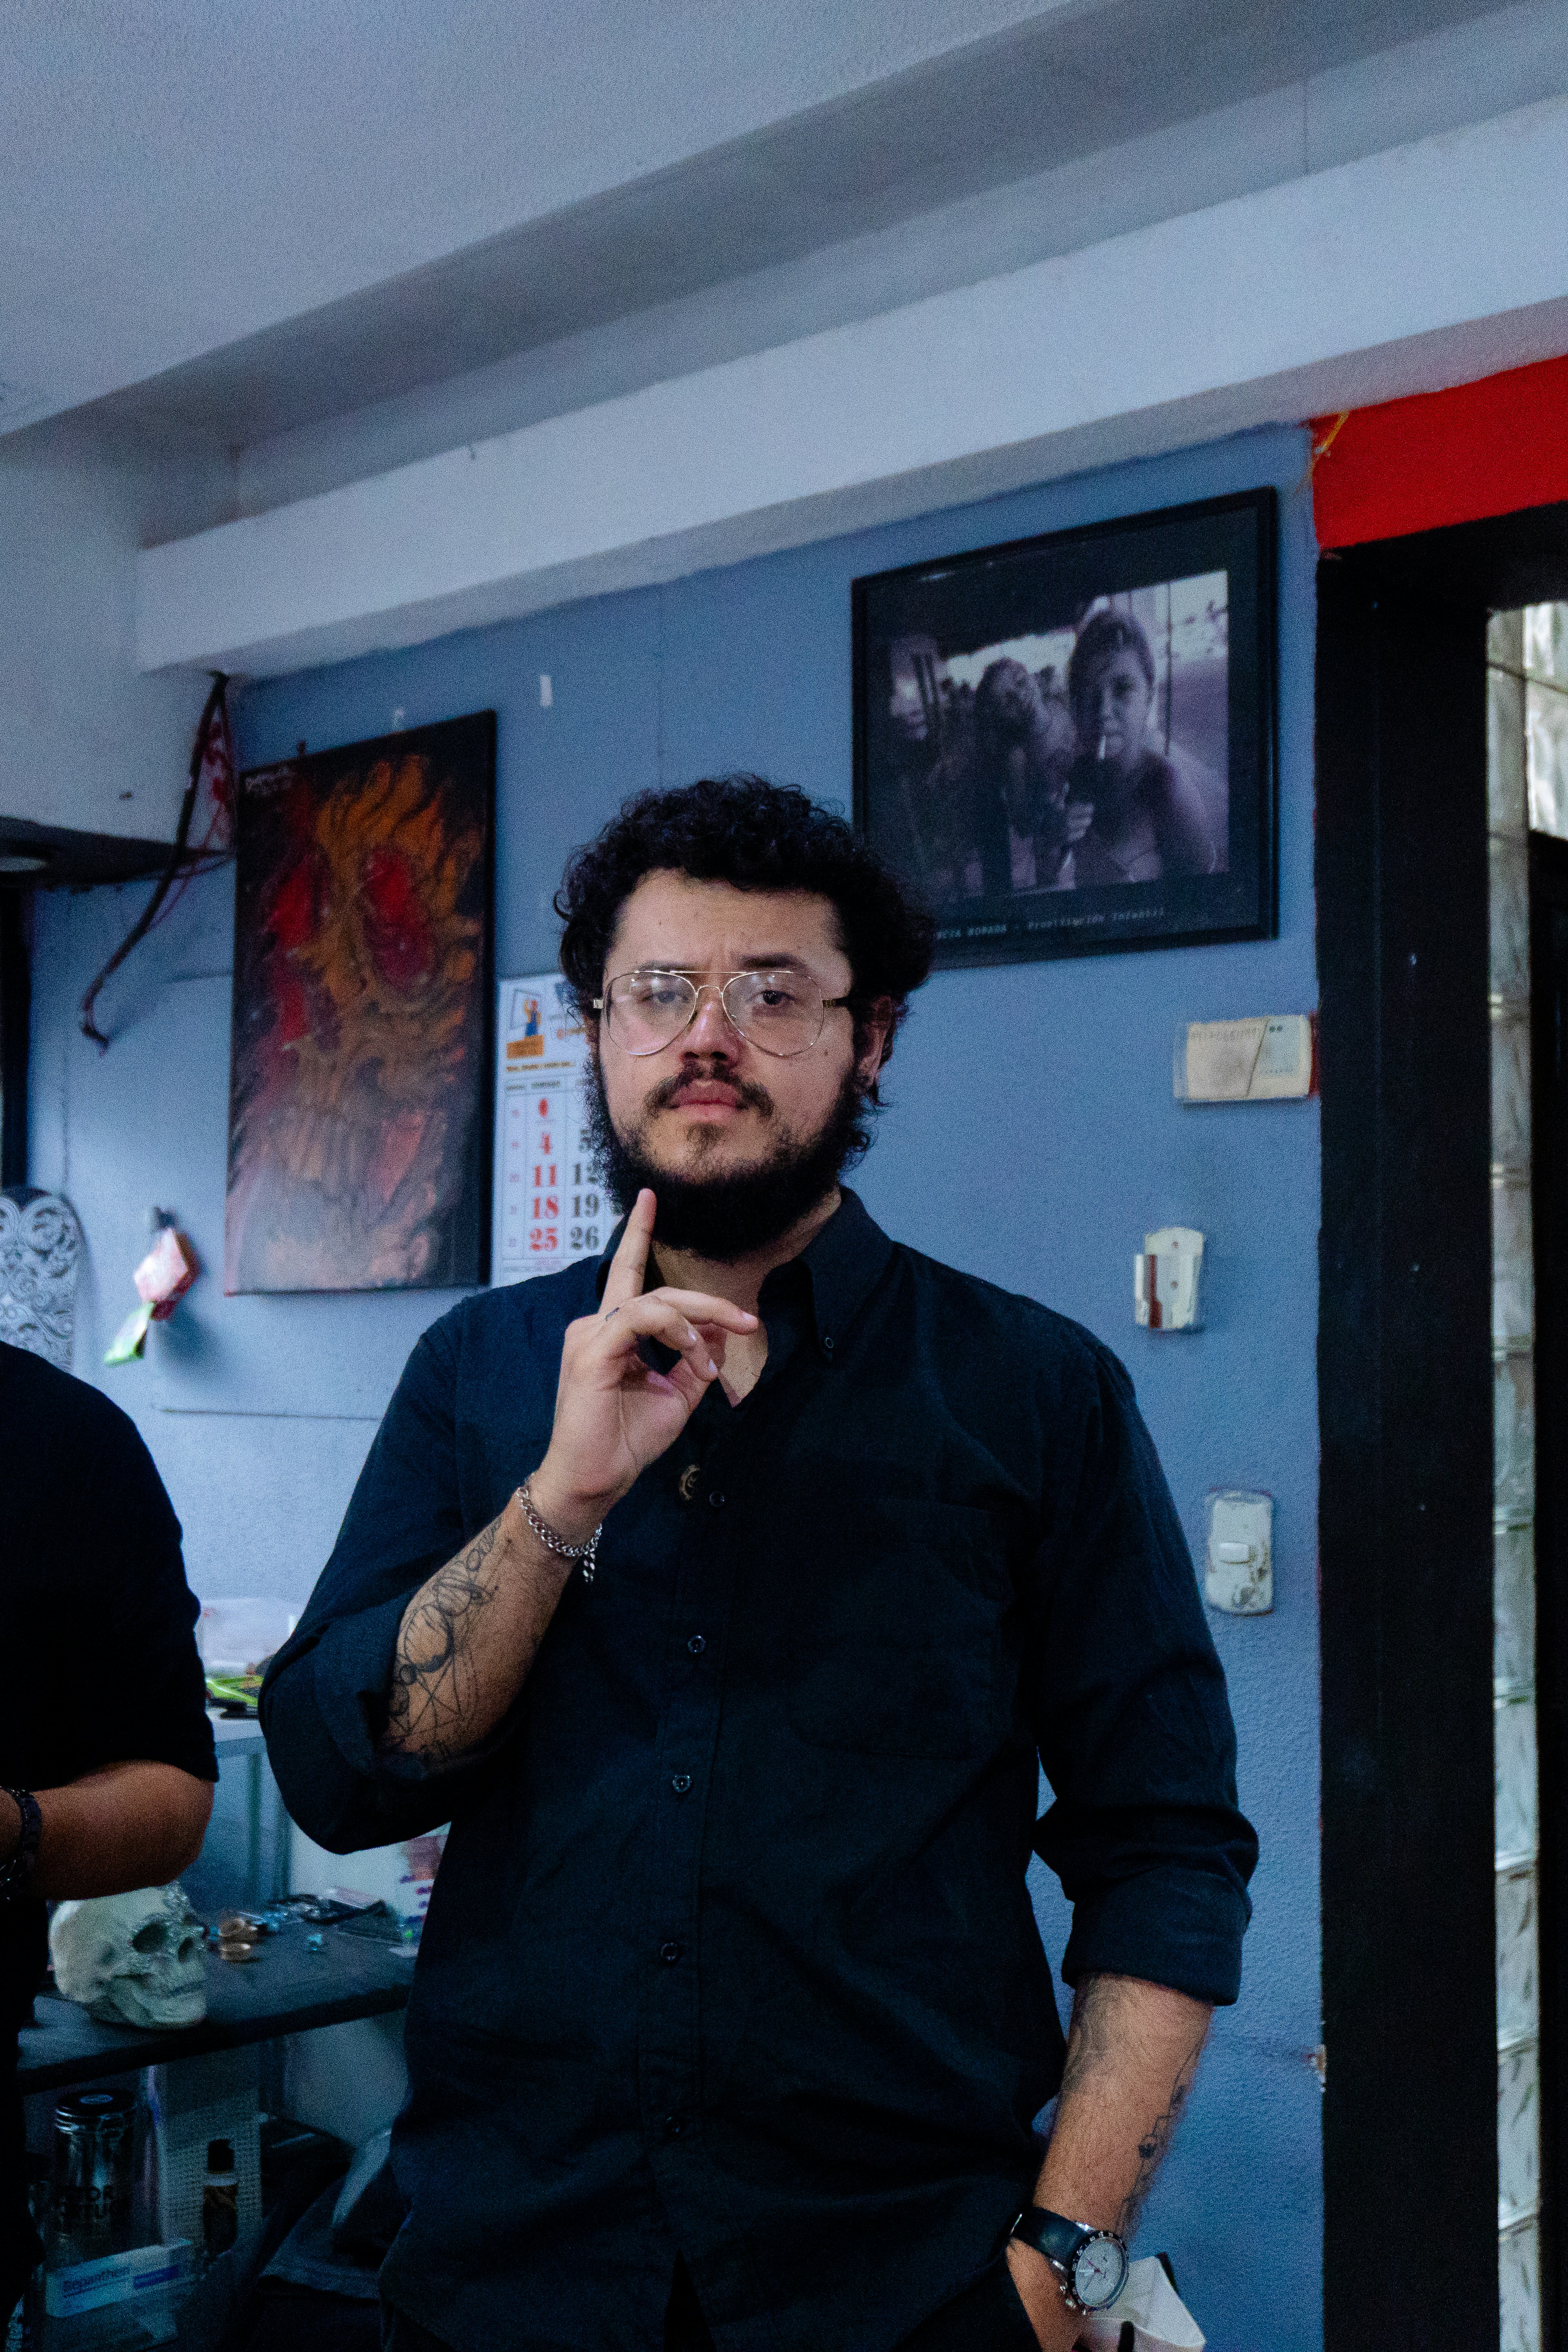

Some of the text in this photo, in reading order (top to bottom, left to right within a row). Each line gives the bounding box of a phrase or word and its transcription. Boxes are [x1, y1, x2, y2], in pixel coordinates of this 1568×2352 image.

[540, 1133, 552, 1155] 4
[533, 1163, 599, 1188] 11 12
[533, 1195, 558, 1219] 18
[571, 1194, 599, 1218] 19
[530, 1226, 599, 1251] 25 26
